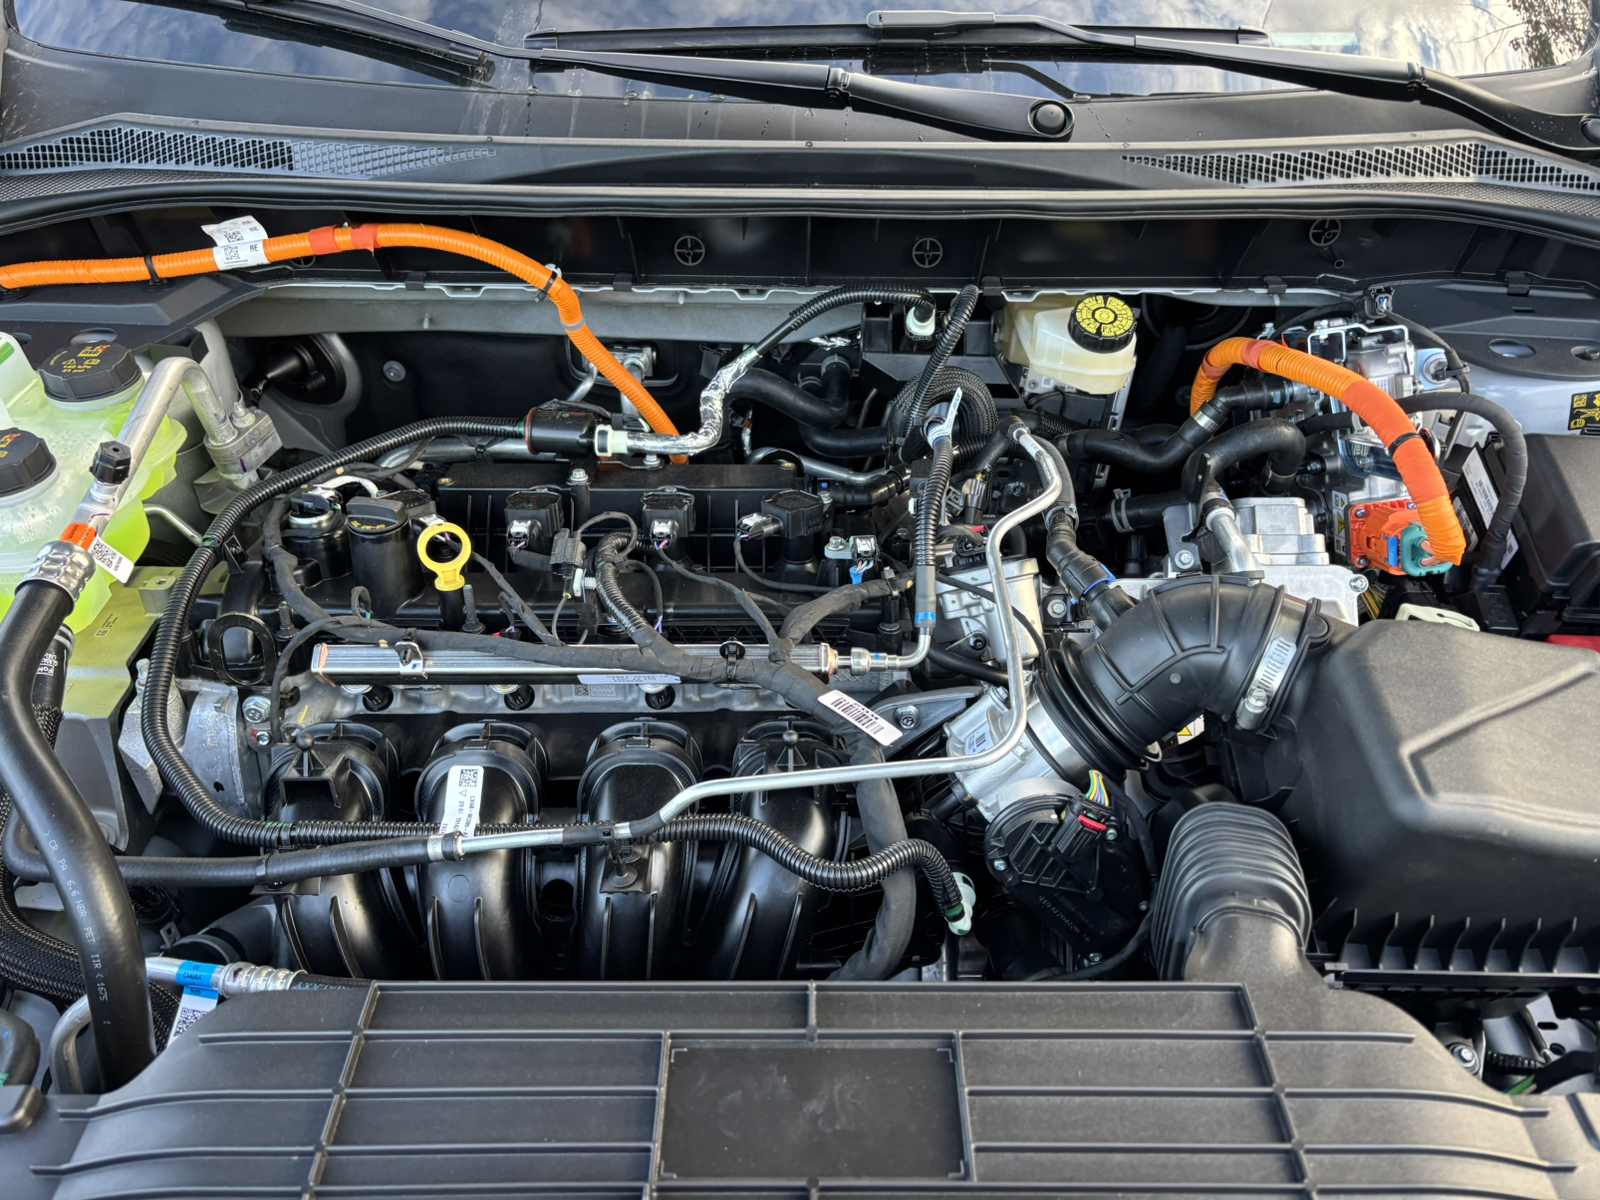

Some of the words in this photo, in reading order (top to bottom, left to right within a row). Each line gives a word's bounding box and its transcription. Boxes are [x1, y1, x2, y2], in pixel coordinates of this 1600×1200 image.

[48, 840, 58, 852] CR
[57, 858, 68, 871] PA
[67, 880, 79, 896] 6.6
[75, 900, 87, 918] NBR
[83, 926, 96, 943] PET
